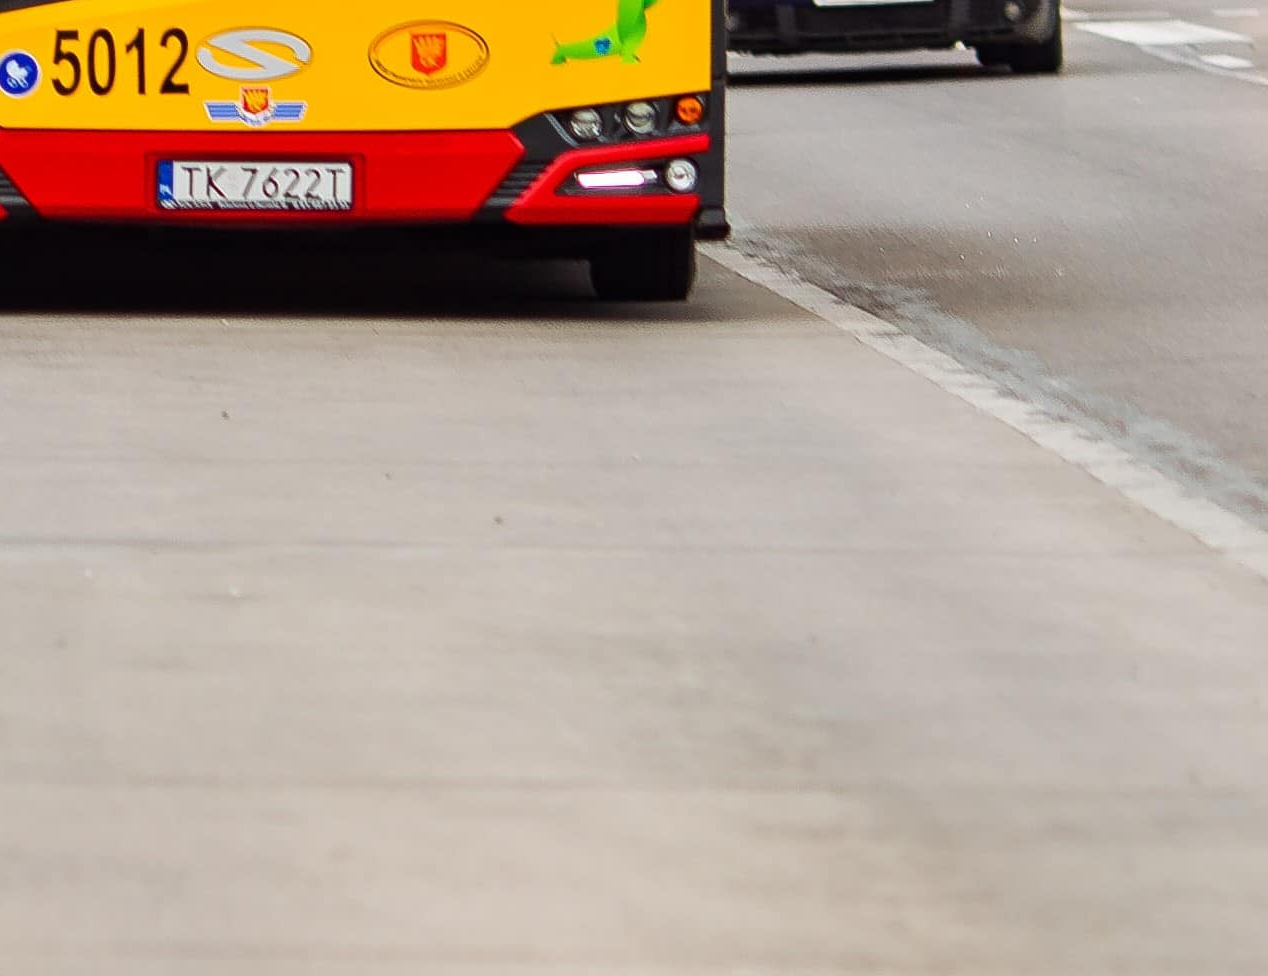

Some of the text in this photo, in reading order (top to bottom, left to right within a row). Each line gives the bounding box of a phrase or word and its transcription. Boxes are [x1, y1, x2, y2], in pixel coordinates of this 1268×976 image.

[51, 27, 189, 96] 5012
[181, 166, 345, 201] TK 7622T
